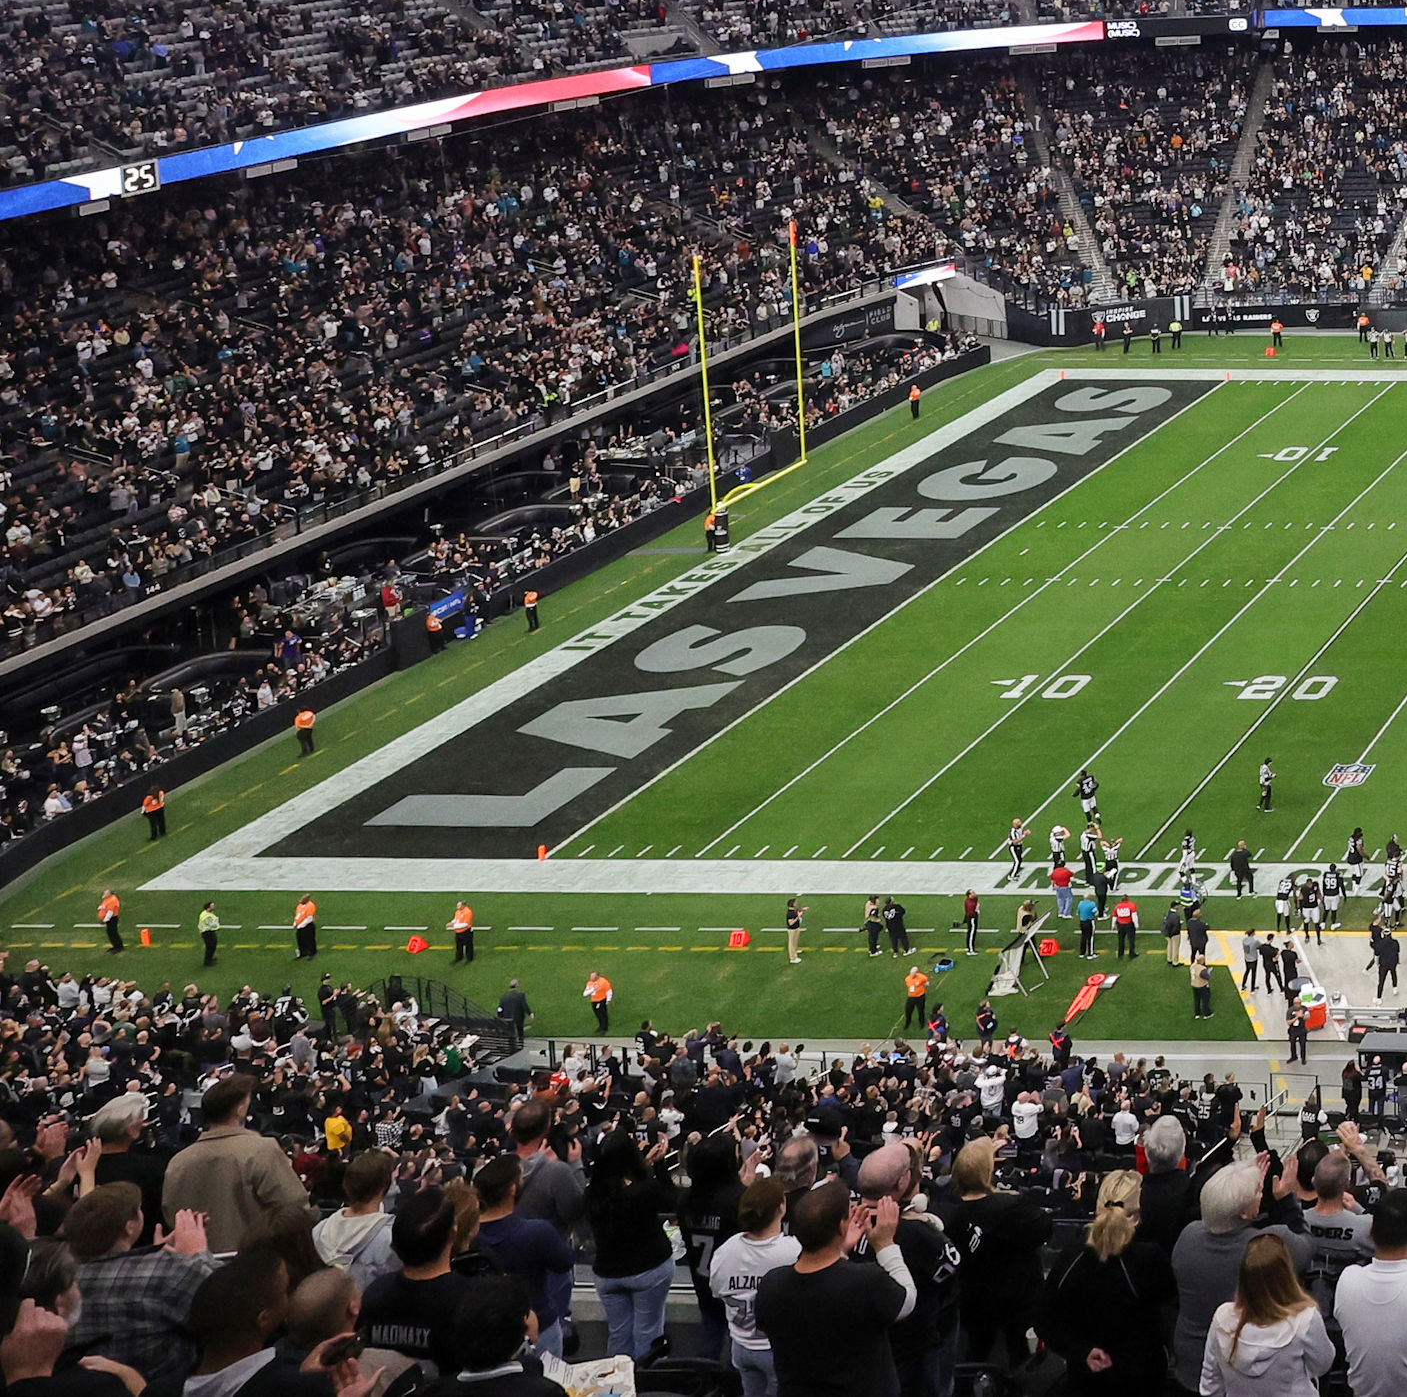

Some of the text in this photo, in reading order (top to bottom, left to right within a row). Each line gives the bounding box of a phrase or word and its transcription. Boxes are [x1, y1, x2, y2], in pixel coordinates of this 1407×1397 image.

[1106, 21, 1137, 30] MUSIC)
[1231, 20, 1245, 30] CC
[1107, 28, 1141, 38] (MUSIC)
[124, 164, 155, 192] 25
[1105, 310, 1147, 323] CHANGE
[1243, 314, 1273, 323] RAIDERS
[558, 469, 895, 651] IT TAKES ALL OF US
[145, 582, 161, 595] 144
[362, 385, 1174, 827] LAS VEGAS
[999, 674, 1093, 700] 10
[1235, 675, 1340, 701] 20
[1330, 772, 1364, 785] NFL
[1324, 877, 1338, 890] 99
[1367, 1076, 1385, 1090] 34
[691, 1234, 715, 1278] 7
[371, 1325, 431, 1349] MADMAXX
